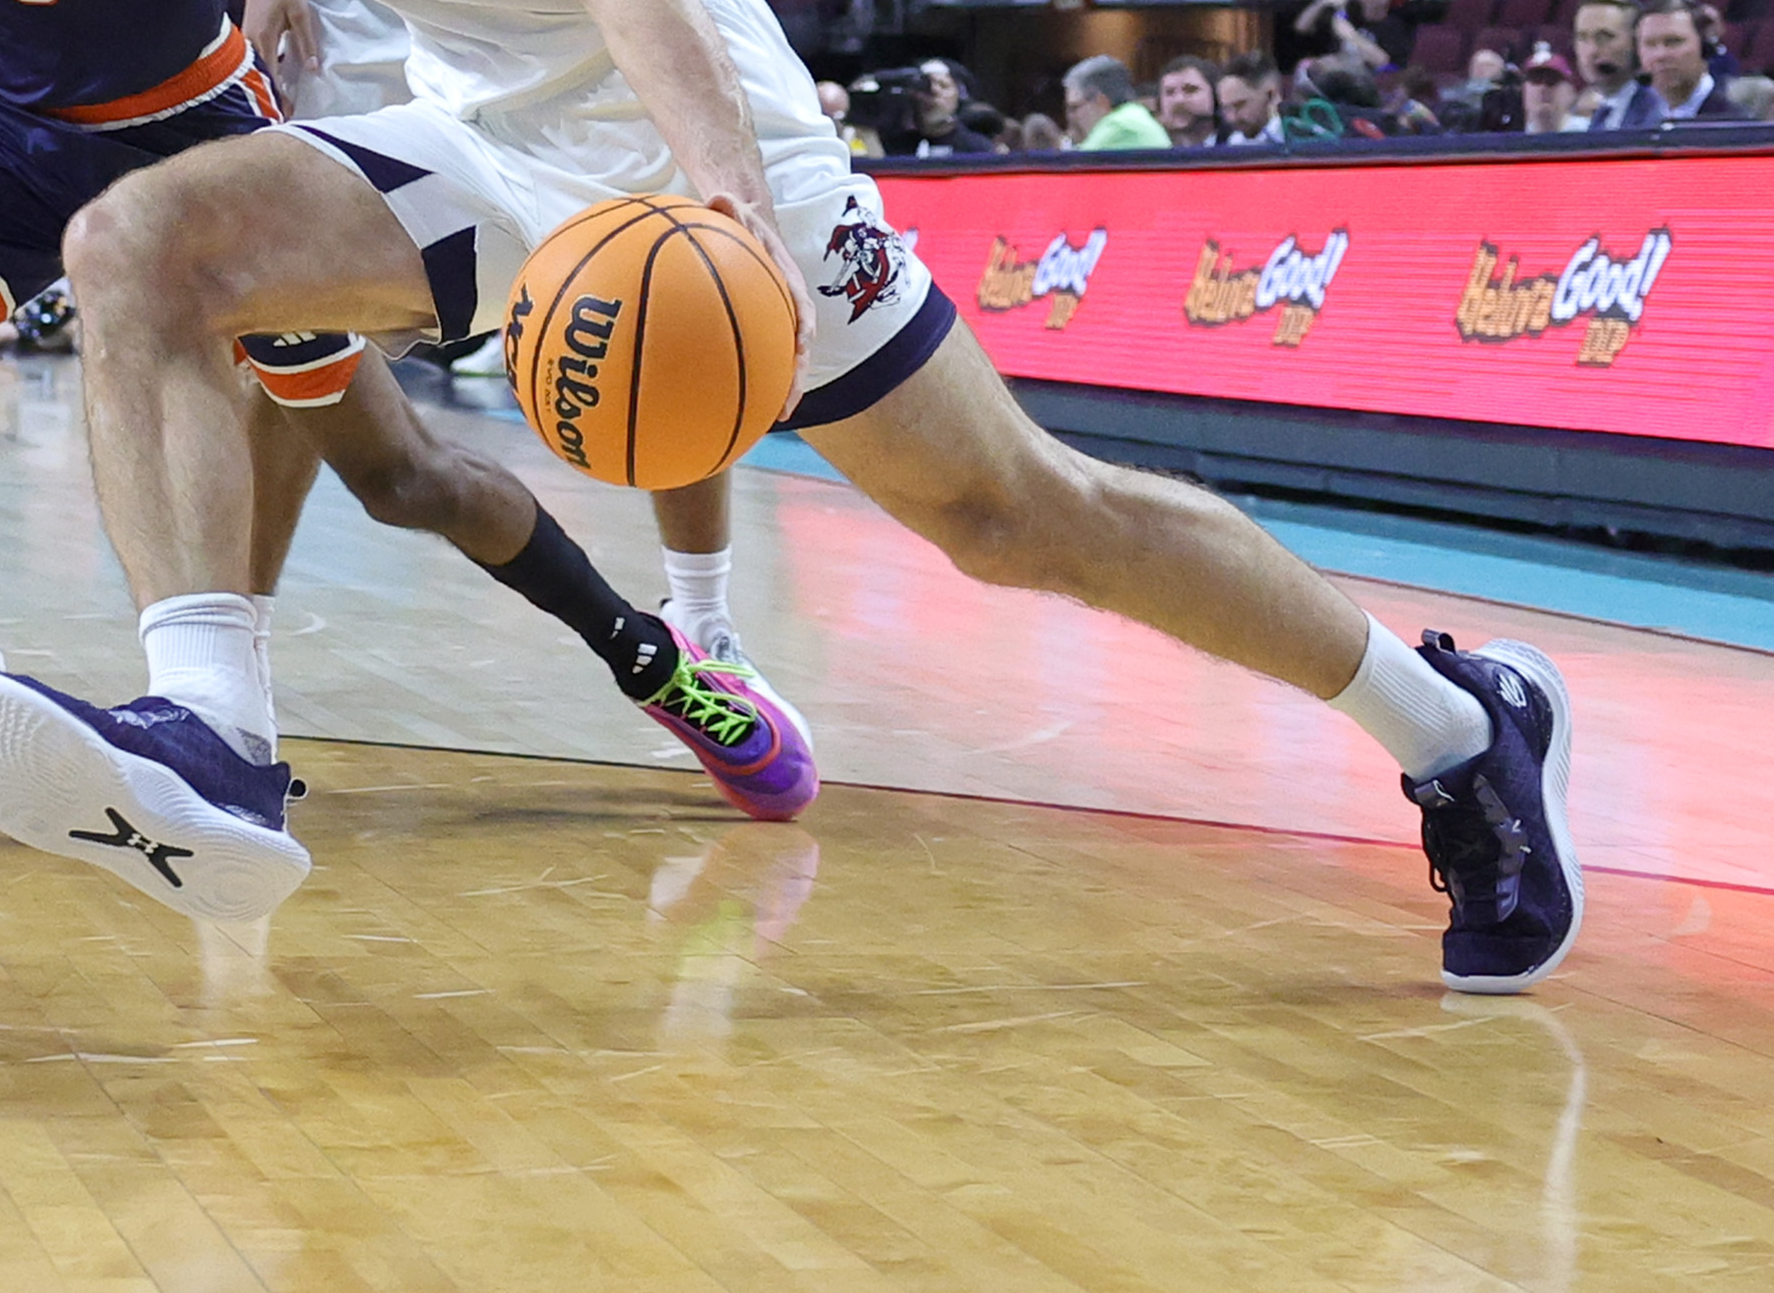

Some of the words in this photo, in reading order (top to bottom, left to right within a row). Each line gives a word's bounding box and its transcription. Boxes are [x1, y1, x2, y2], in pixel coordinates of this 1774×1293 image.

[1254, 229, 1350, 310] Good!
[1550, 229, 1673, 323] Good!
[554, 293, 624, 470] Wilson
